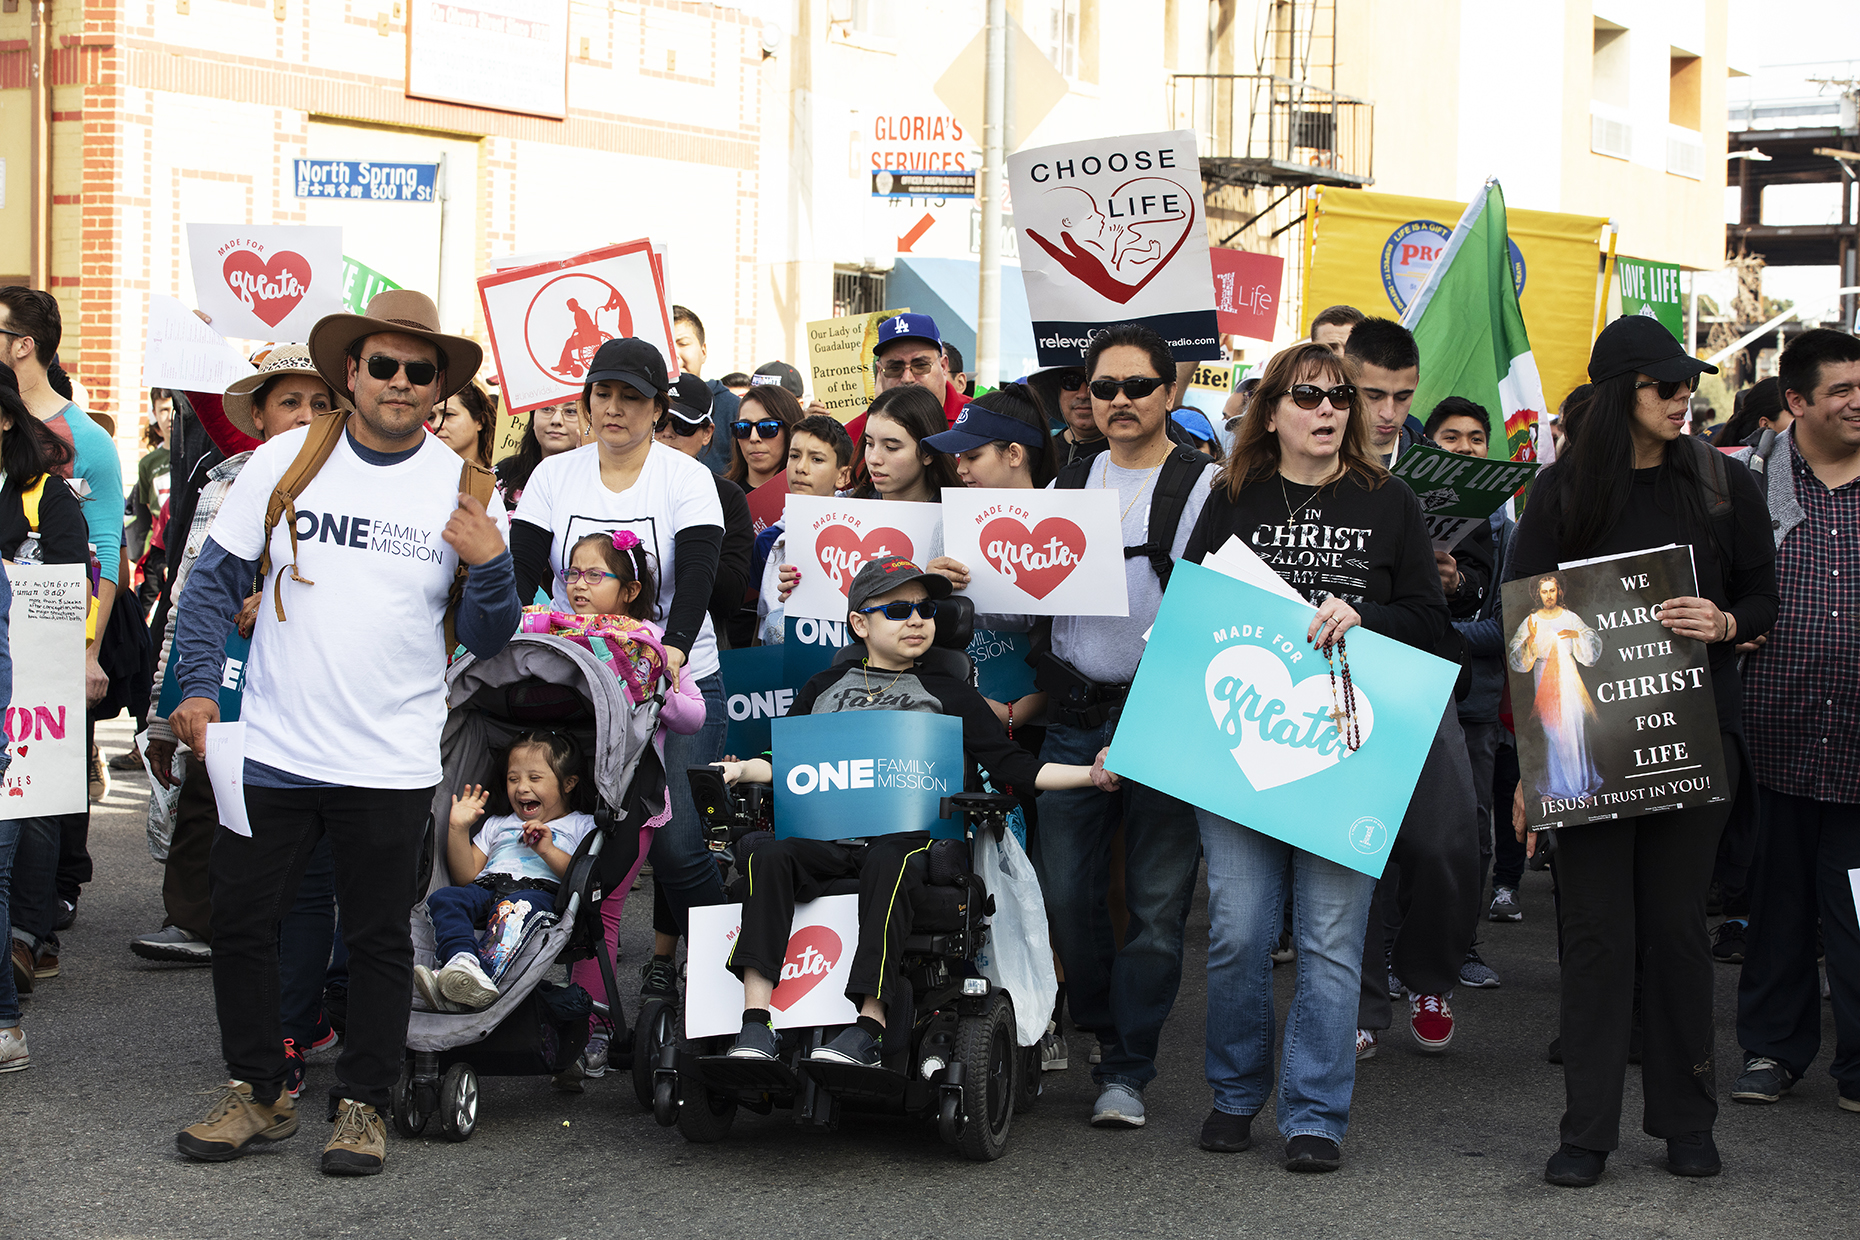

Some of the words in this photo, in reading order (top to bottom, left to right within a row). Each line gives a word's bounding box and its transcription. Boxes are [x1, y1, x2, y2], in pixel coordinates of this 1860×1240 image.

[875, 116, 963, 141] GLORIA'S
[871, 151, 965, 170] SERVICES
[1030, 148, 1176, 183] CHOOSE
[298, 160, 350, 183] North
[358, 162, 418, 193] Spring
[371, 184, 397, 199] 600
[417, 185, 431, 200] St
[1108, 194, 1180, 218] LIFE
[1394, 225, 1411, 242] LIFE
[1412, 223, 1420, 231] IS
[1429, 224, 1448, 236] GIFT
[217, 238, 241, 257] MADE
[246, 238, 265, 252] FOR
[230, 268, 307, 311] greater
[1620, 262, 1646, 300] LOVE
[1650, 267, 1678, 304] LIFE
[1239, 285, 1272, 315] Life
[810, 329, 827, 340] Our
[828, 327, 850, 340] Lady
[852, 323, 863, 334] of
[894, 316, 910, 334] LA
[814, 339, 862, 354] Guadalupe
[1039, 332, 1094, 348] releva
[813, 364, 869, 379] Patroness
[1191, 367, 1229, 388] ife!
[827, 383, 839, 393] of
[841, 381, 858, 391] the
[818, 394, 875, 410] mericas
[1395, 451, 1474, 485] LOVE
[1464, 464, 1532, 493] LIFE
[812, 512, 837, 530] MADE
[842, 513, 863, 528] FOR
[974, 504, 1002, 525] MADE
[1008, 505, 1029, 519] FOR
[1304, 508, 1322, 521] IN
[295, 509, 370, 549] ONE
[372, 520, 431, 544] FAMILY
[1251, 523, 1372, 553] CHRIST
[371, 536, 443, 564] MISSION
[987, 536, 1081, 584] greater
[1270, 549, 1343, 568] ALONE
[1292, 570, 1318, 584] MY
[1620, 573, 1650, 591] WE
[1595, 603, 1664, 631] MARC
[795, 617, 849, 648] ON
[966, 629, 997, 650] MILY
[1213, 624, 1264, 643] MADE
[1272, 633, 1303, 664] FOR
[968, 637, 1014, 664] SSION
[1618, 640, 1673, 662] WITH
[1596, 666, 1705, 704] CHRIST
[727, 688, 794, 721] ONE
[1213, 675, 1348, 761] greater
[1635, 711, 1677, 731] FOR
[1633, 742, 1689, 767] LIFE
[786, 758, 875, 795] ONE
[877, 758, 936, 775] FAMILY
[877, 774, 947, 792] MISSION
[1541, 796, 1590, 818] JESUS,
[1593, 795, 1599, 807] I
[1601, 788, 1646, 805] TRUST
[1649, 785, 1667, 798] IN
[1667, 775, 1711, 795] YOU!
[726, 925, 742, 941] MA
[779, 945, 832, 981] ater
